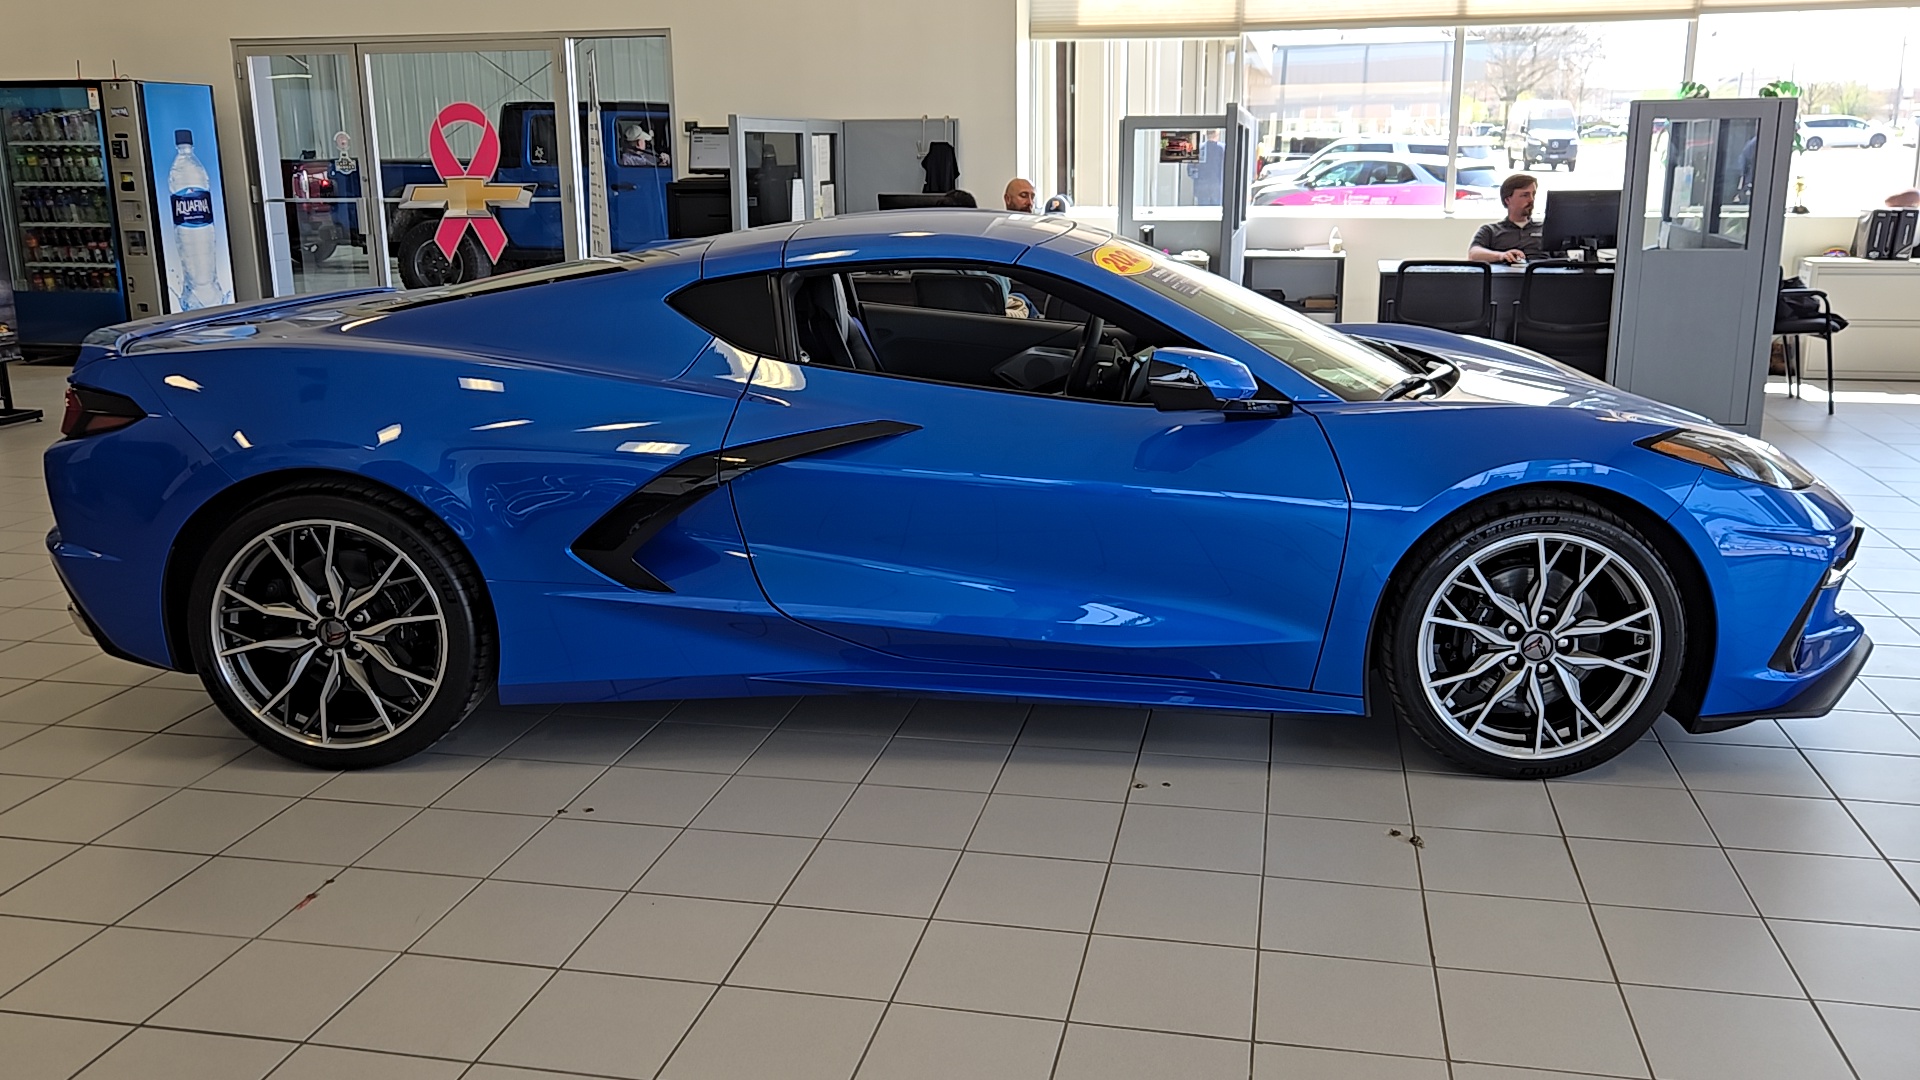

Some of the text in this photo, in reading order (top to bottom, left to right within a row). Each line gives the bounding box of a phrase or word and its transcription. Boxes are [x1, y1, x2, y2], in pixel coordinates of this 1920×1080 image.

[175, 198, 210, 216] AQUAFINA
[1101, 248, 1143, 272] 202
[1486, 517, 1555, 536] MICHELIN
